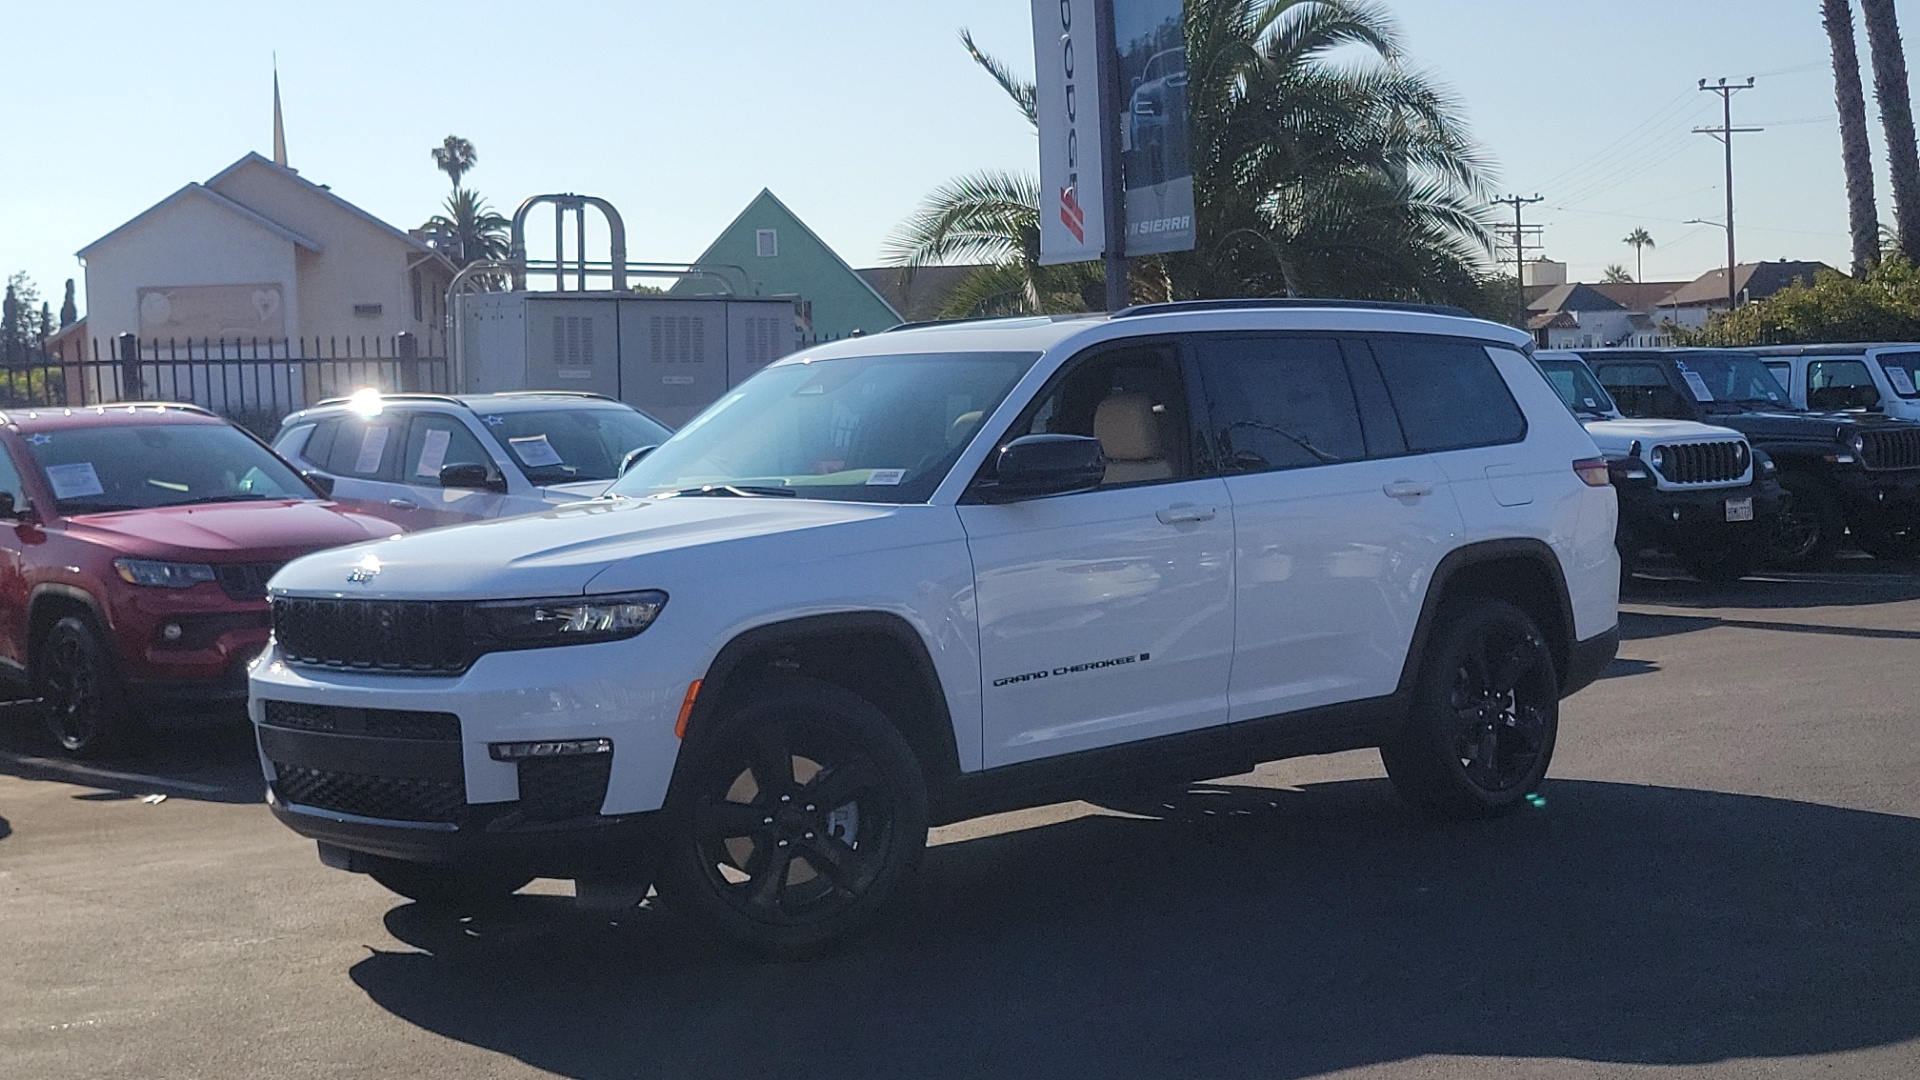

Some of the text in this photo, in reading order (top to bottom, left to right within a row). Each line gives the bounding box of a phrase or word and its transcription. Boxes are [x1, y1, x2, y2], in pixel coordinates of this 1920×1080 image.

[1140, 216, 1190, 234] SIERRA
[993, 670, 1048, 687] GRAND
[1053, 655, 1135, 676] CHEROKEE
